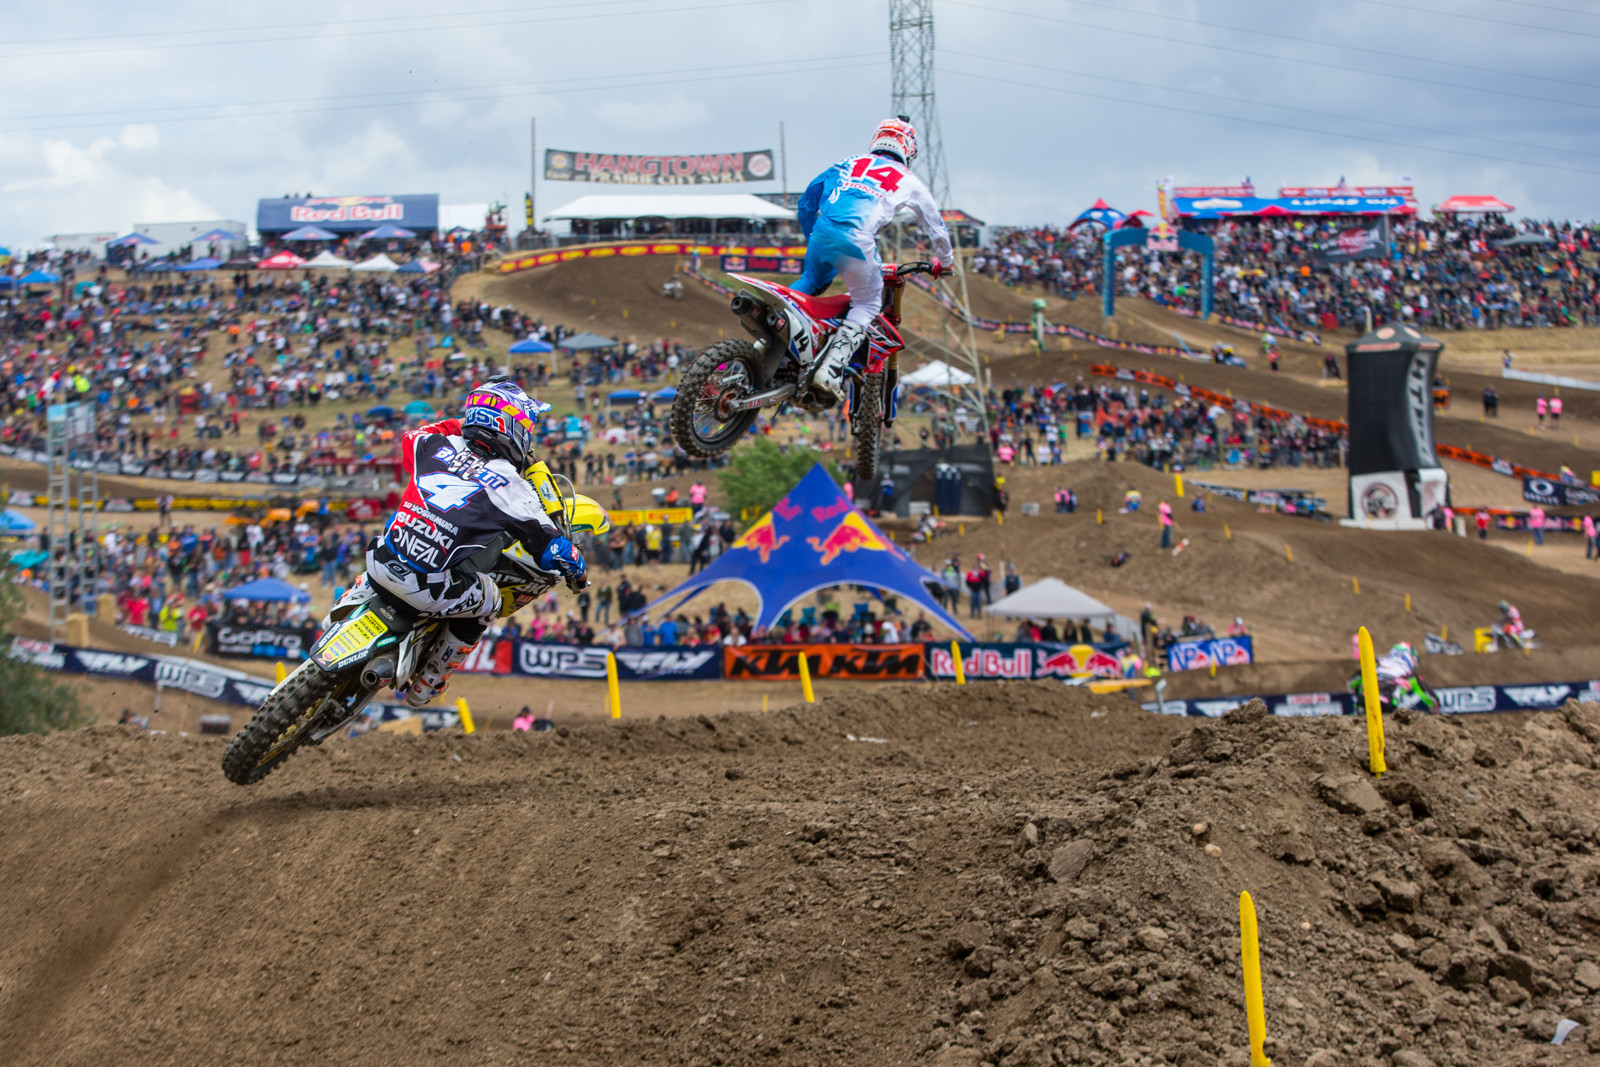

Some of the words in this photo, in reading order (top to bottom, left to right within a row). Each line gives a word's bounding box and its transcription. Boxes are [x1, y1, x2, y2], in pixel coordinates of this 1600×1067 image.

[575, 153, 744, 176] HANGTOWN
[851, 158, 904, 192] 14
[291, 205, 347, 222] Red
[349, 204, 404, 221] Bull
[417, 471, 486, 512] 4
[397, 511, 454, 550] SUZUKI
[217, 627, 302, 649] GoPro
[338, 650, 369, 668] DUNLOP
[519, 642, 608, 677] WPS
[730, 649, 821, 676] KTM
[827, 649, 921, 675] KTM
[982, 648, 1032, 677] Bull
